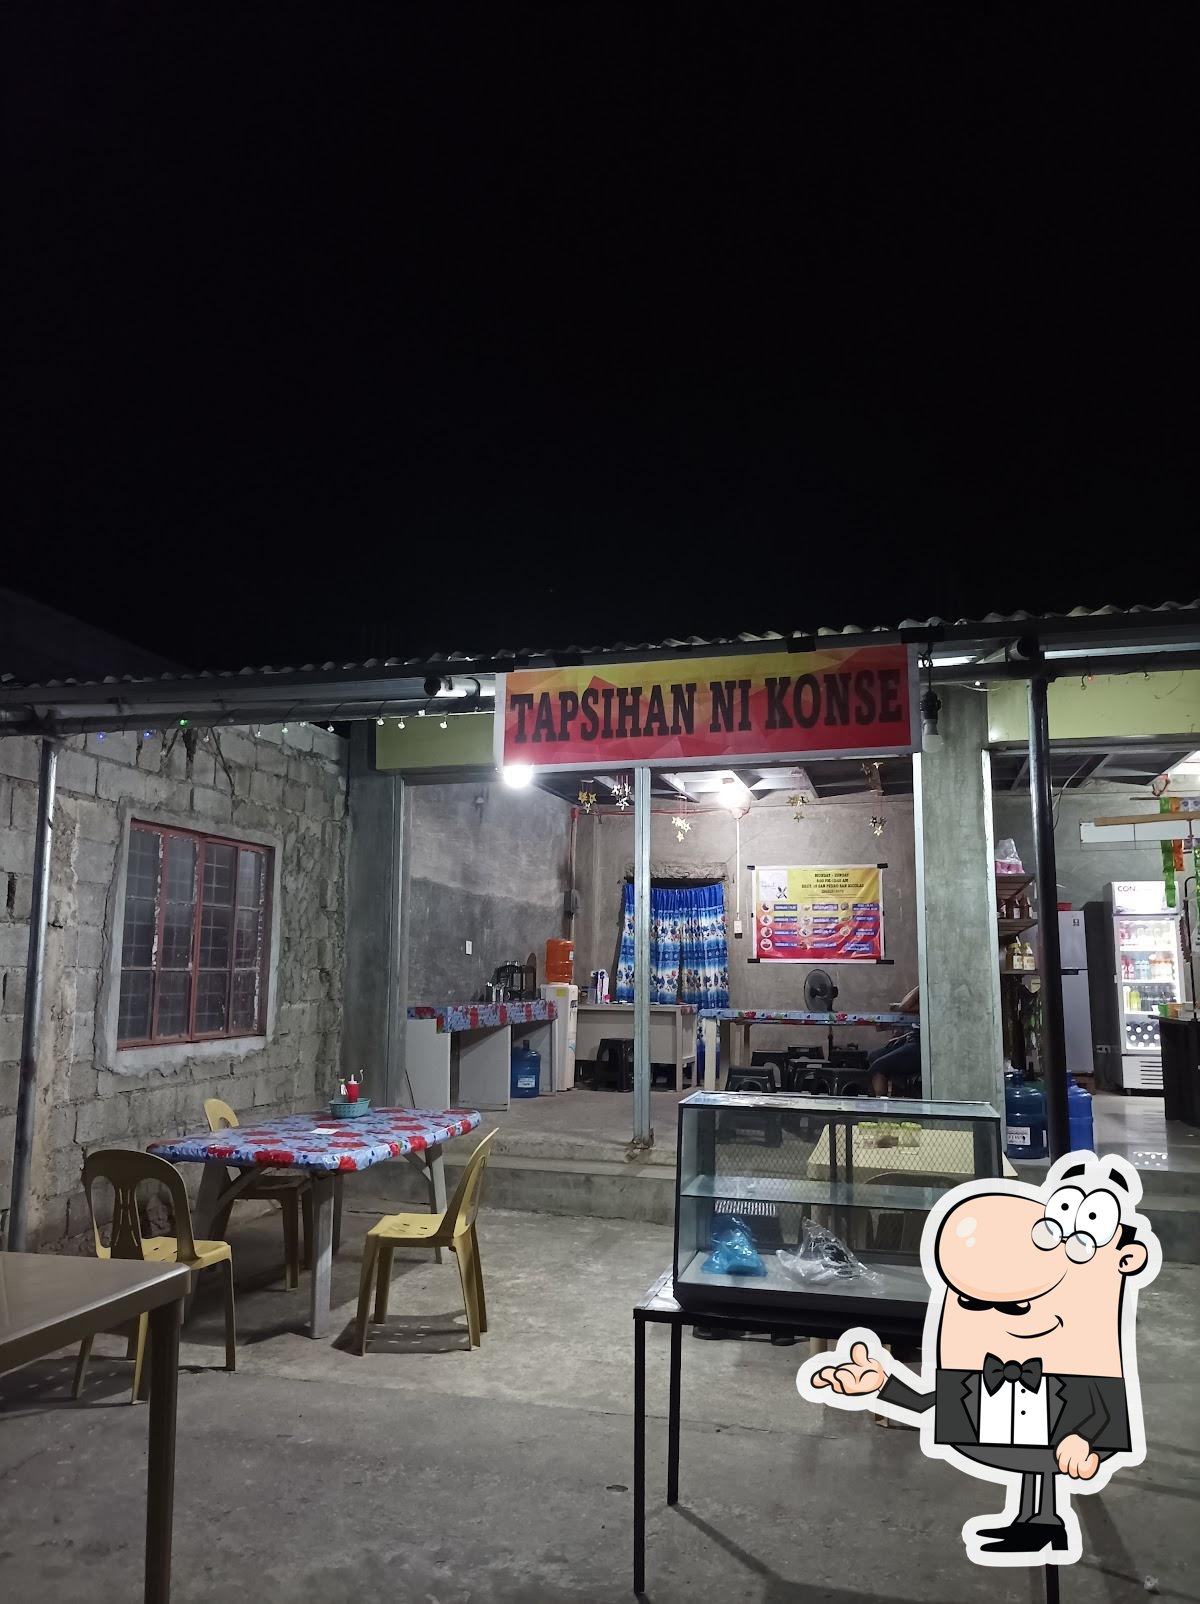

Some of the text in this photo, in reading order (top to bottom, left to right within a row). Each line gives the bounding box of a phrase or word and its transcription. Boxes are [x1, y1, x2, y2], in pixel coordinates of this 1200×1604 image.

[510, 669, 904, 743] TAPSIHAN NI KONSE
